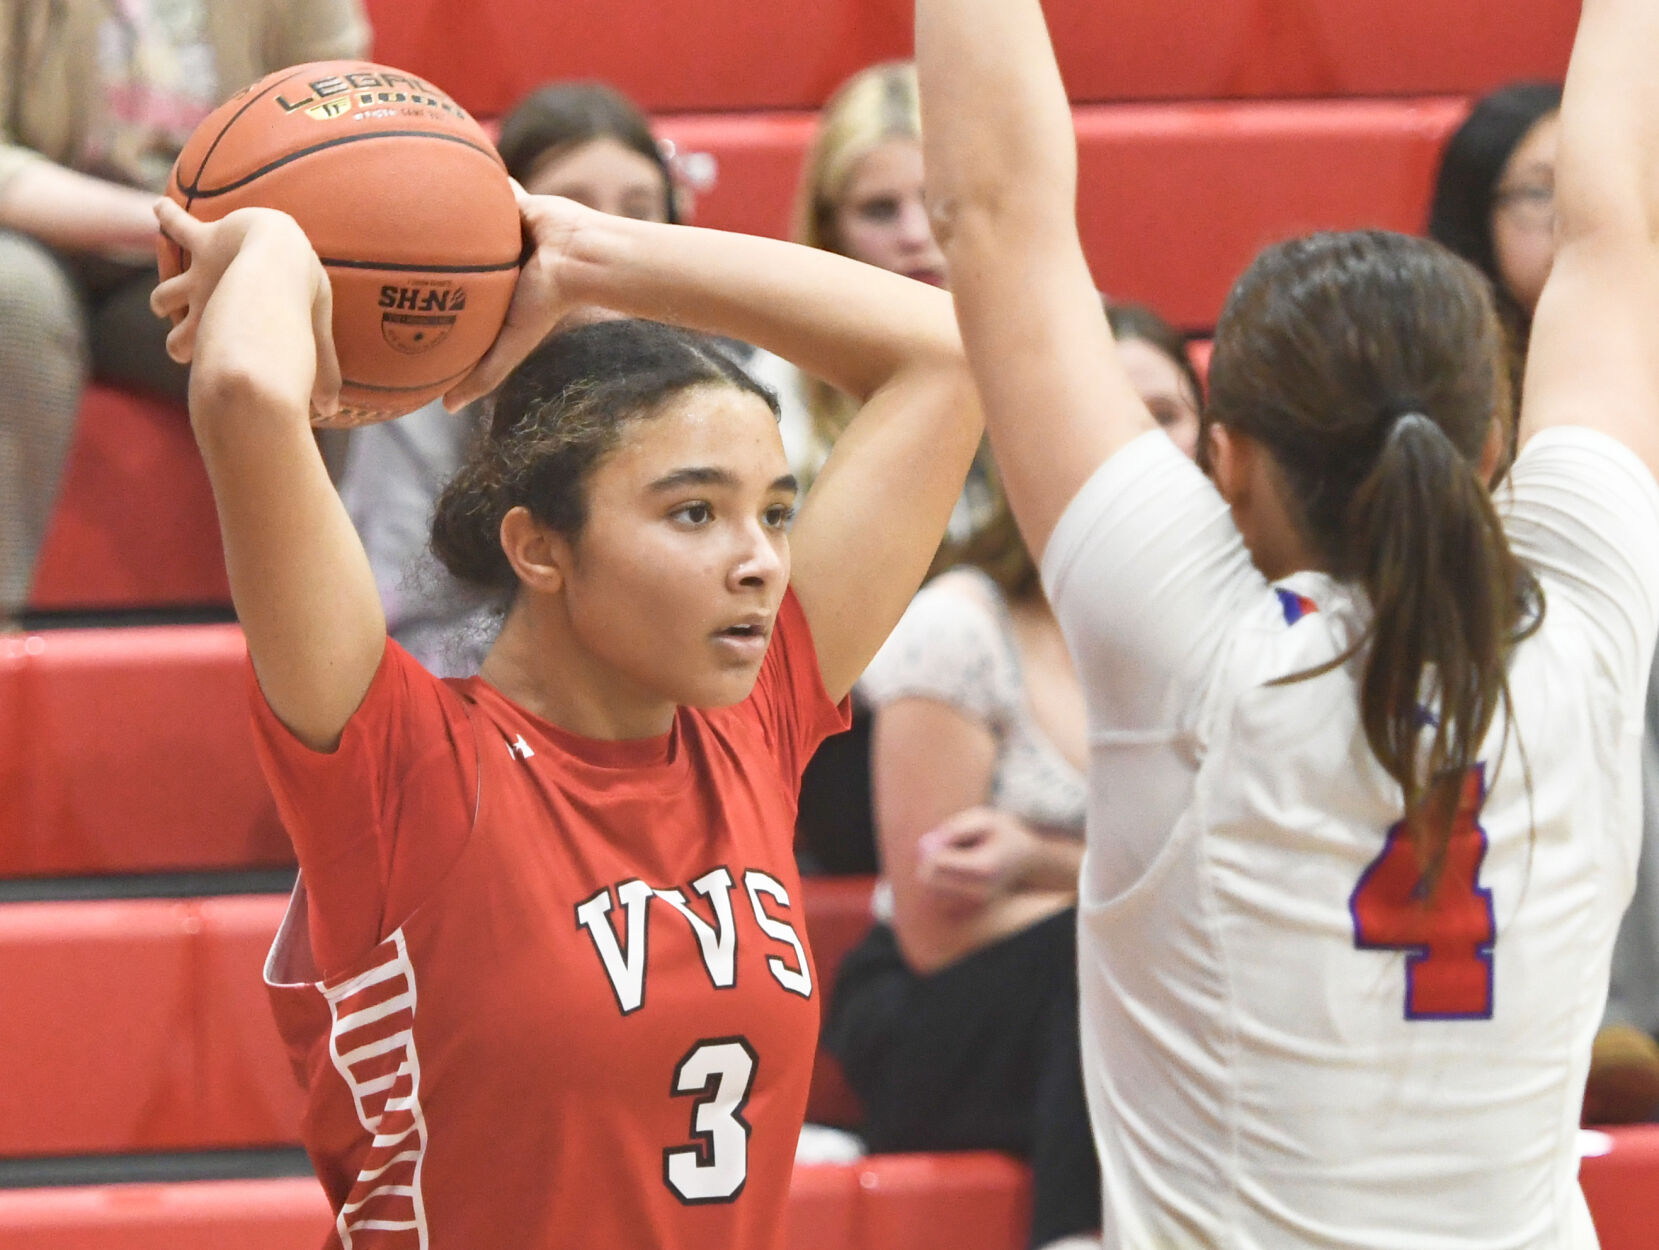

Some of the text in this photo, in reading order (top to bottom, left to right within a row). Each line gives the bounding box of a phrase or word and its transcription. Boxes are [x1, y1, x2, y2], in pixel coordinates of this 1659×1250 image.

[274, 72, 444, 114] LEGAC
[378, 284, 451, 312] NFHS
[576, 864, 814, 1016] VVS
[1349, 760, 1497, 1021] 4
[663, 1034, 760, 1204] 3
